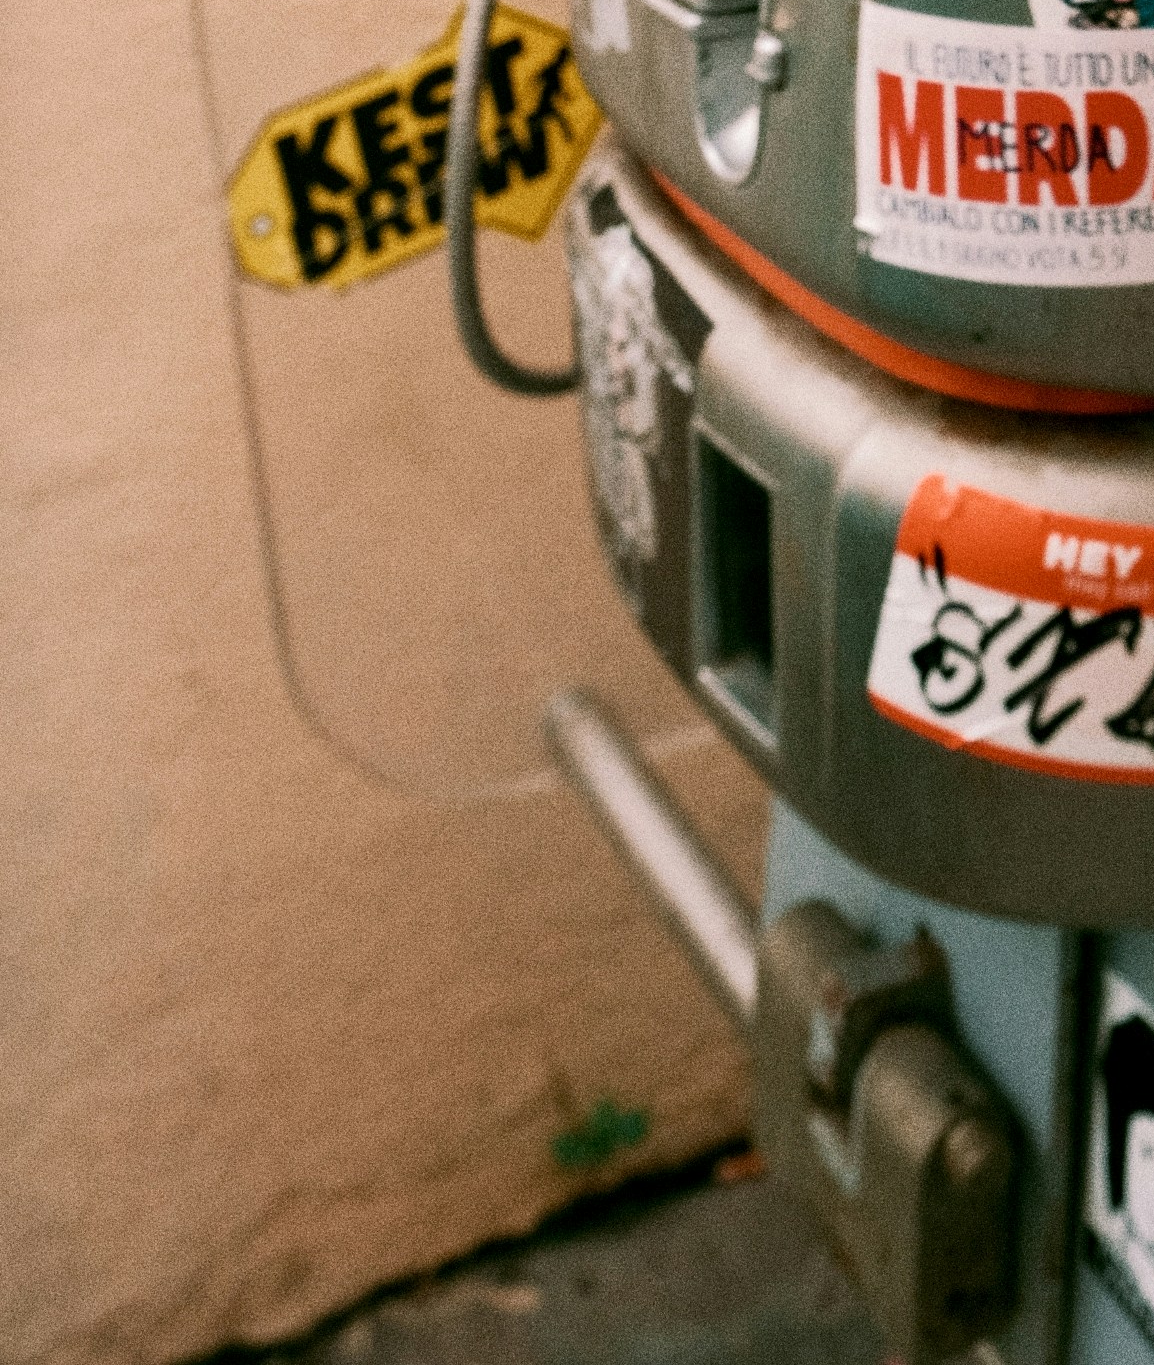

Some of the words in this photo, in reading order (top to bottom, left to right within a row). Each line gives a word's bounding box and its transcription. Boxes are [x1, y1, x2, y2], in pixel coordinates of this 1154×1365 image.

[954, 115, 1121, 176] MERDA
[988, 201, 1043, 236] CON
[1042, 531, 1143, 578] HEY
